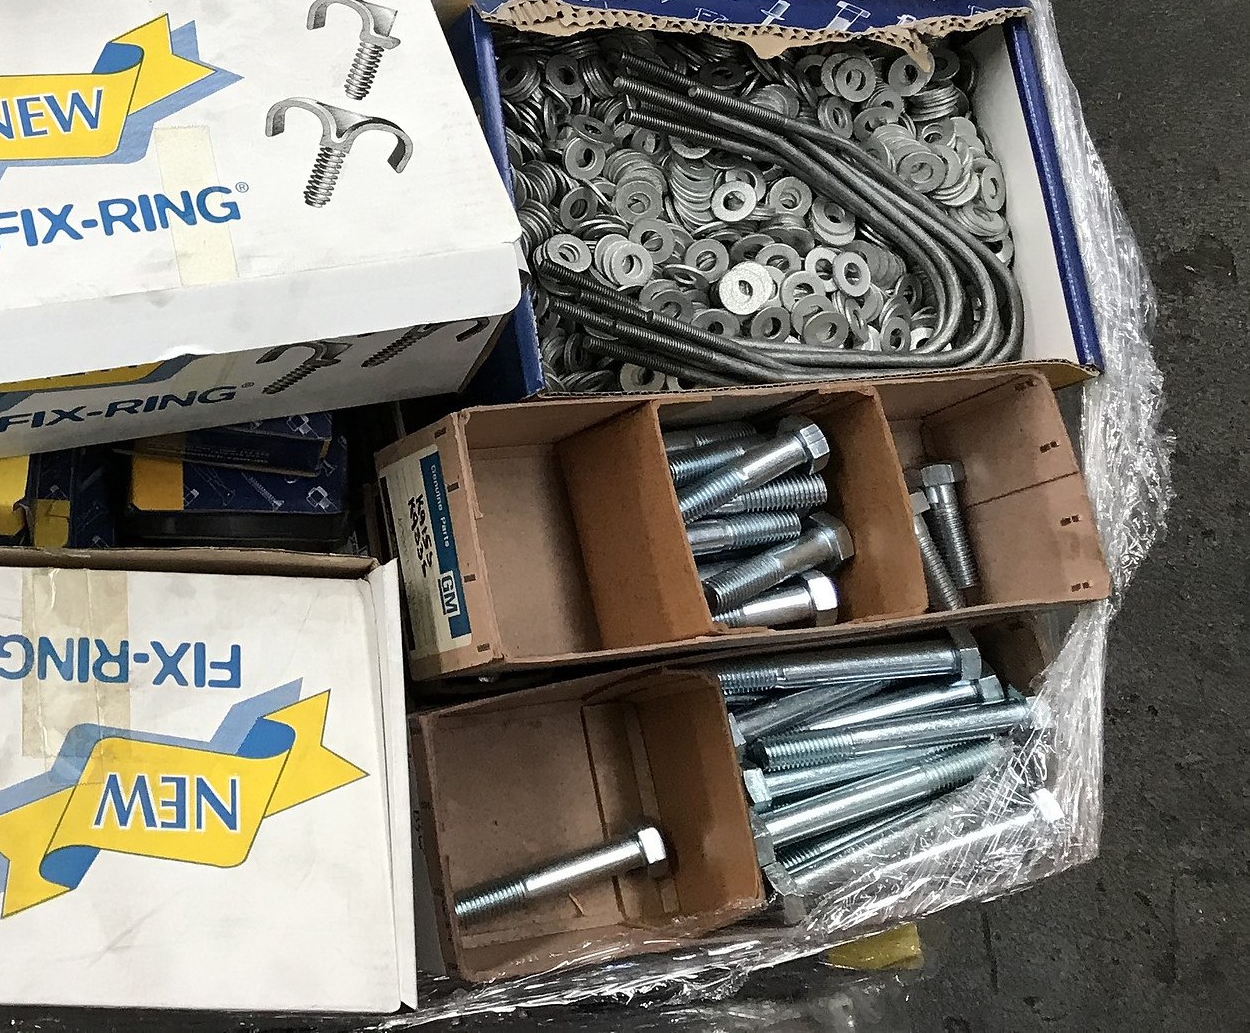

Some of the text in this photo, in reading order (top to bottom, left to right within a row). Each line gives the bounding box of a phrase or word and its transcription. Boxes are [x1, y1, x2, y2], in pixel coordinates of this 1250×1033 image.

[430, 464, 450, 548] Genuine Parts
[441, 574, 458, 615] GM
[93, 773, 239, 833] NEW
